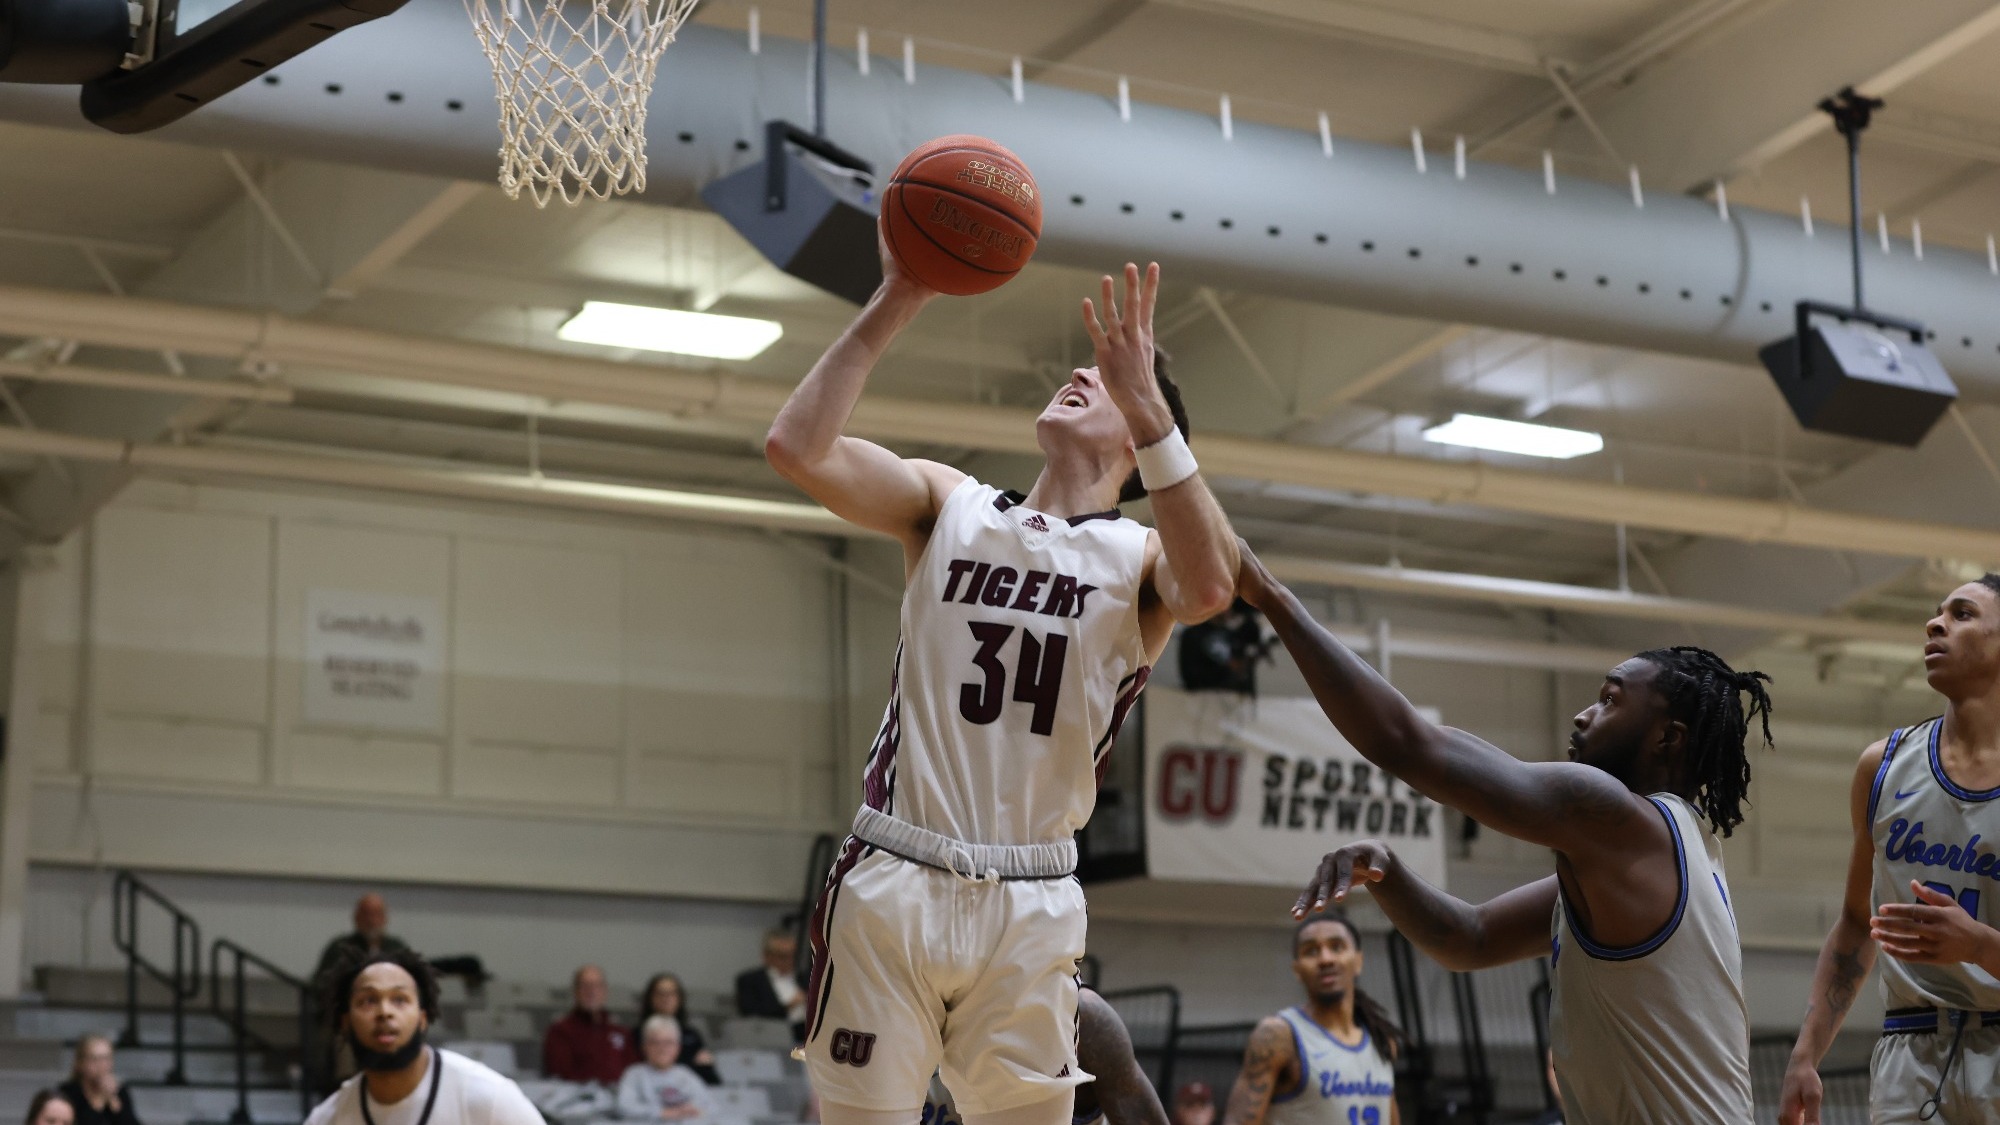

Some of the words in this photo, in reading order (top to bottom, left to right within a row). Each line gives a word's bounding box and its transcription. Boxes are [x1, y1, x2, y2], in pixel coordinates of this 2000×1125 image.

[957, 168, 1036, 217] LEGACY
[960, 620, 1068, 737] 34
[1157, 743, 1243, 824] CU
[1261, 795, 1433, 837] NETWORK
[830, 1028, 876, 1067] CU
